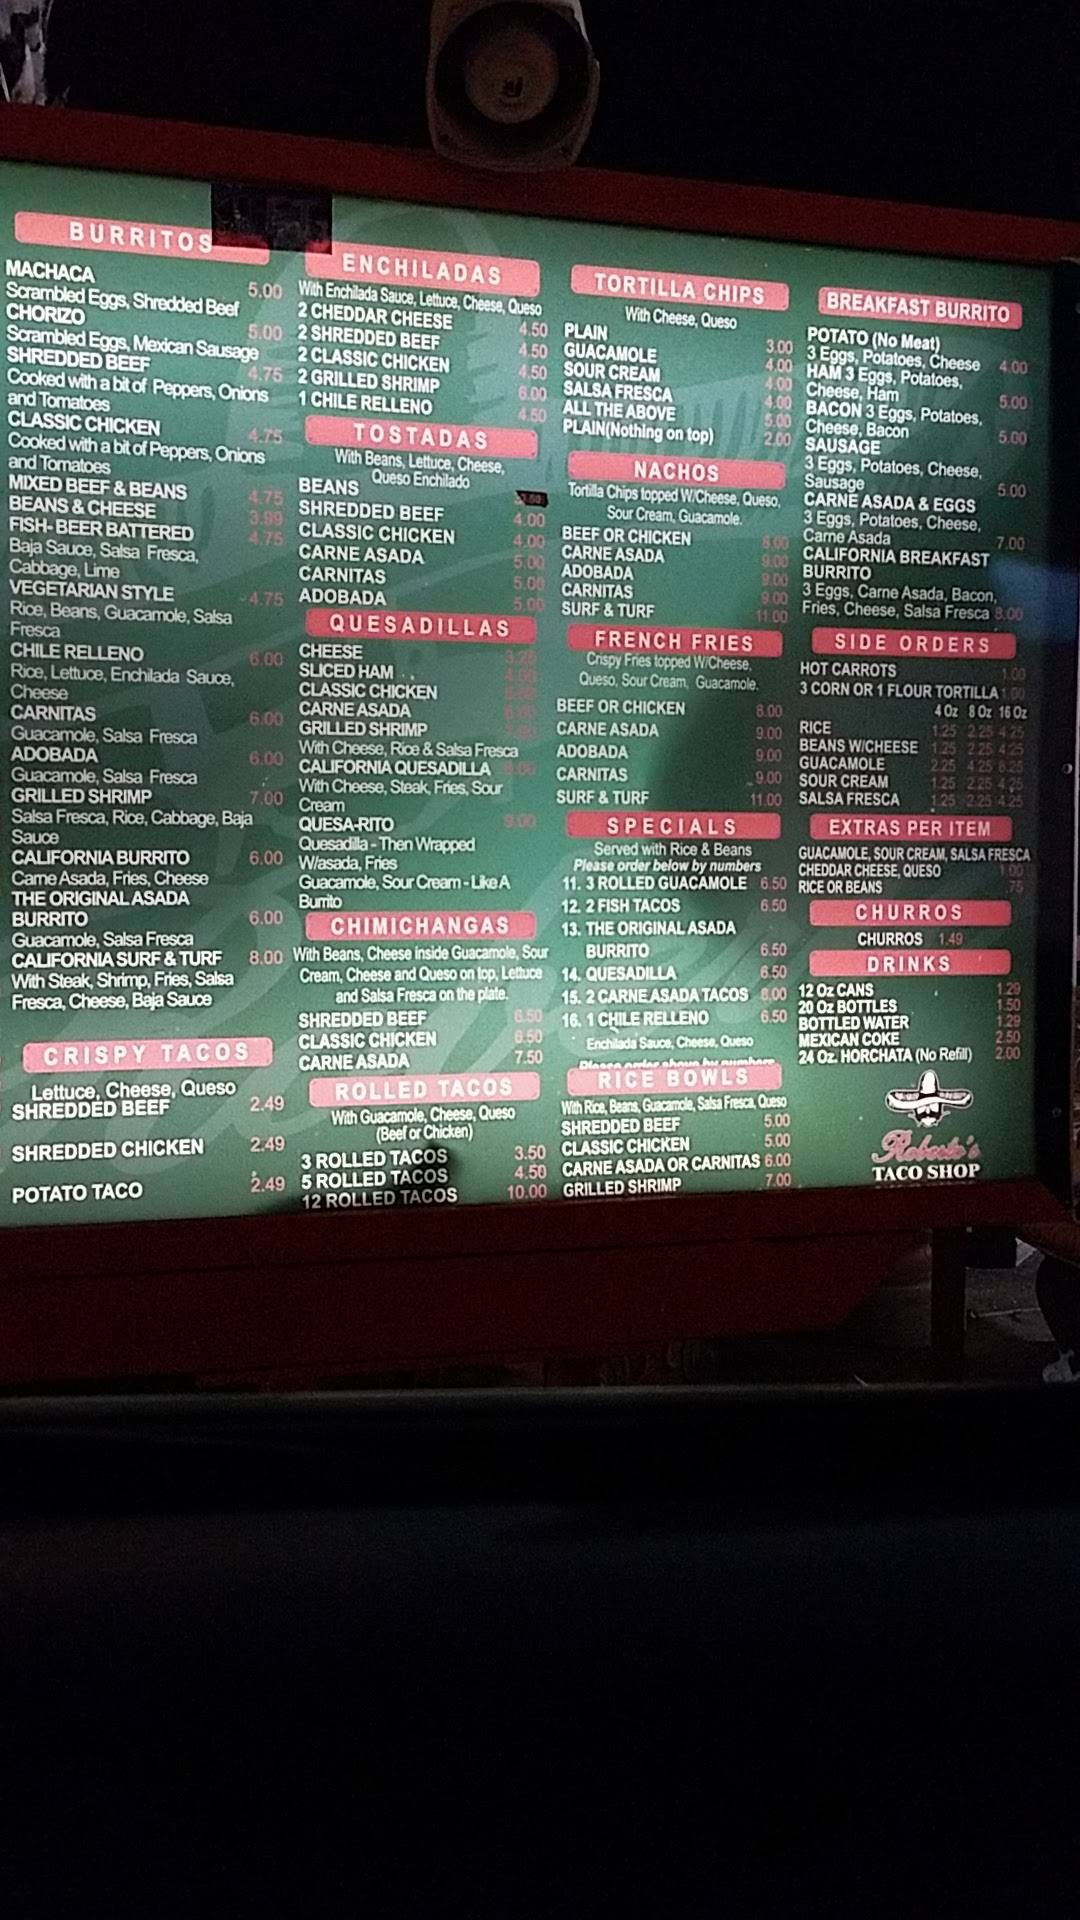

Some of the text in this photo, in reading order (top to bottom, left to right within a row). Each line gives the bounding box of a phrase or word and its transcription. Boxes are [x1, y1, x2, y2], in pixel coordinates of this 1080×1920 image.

[69, 221, 213, 253] BURRITOS
[5, 259, 282, 299] MACHACA 5.00
[343, 254, 501, 285] ENCHILADAS
[6, 282, 240, 317] Scrambled Eggs, Shredded Beef
[299, 280, 542, 317] With Enchilada Sauce, Lettuce, Cheese, Queso
[595, 273, 764, 304] TORTILLA CHIPS
[626, 306, 737, 330] With Cheese, Queso
[827, 292, 1010, 323] BREAKFAST BURRITO
[6, 303, 282, 341] CHORIZO 5.00
[298, 302, 548, 337] 2 CHEDDAR CHEESE 4.50
[808, 327, 940, 352] POTATO (No Meat)
[7, 346, 150, 372] SHREDDED BEEF
[564, 342, 792, 372] GUACAMOLE 4.00
[807, 364, 962, 389] HAM 3 Eggs, Potatoes,
[806, 383, 1027, 409] Cheese, Ham 5.00
[563, 400, 676, 422] ALL THE ABOVE
[354, 423, 488, 450] TOSTADAS
[667, 428, 682, 440] on
[687, 428, 714, 446] top)
[372, 469, 469, 489] Queso Enchilado
[634, 460, 719, 482] NACHOS
[9, 475, 283, 506] MIXED BEEF & BEANS 4.75
[56, 519, 101, 536] BEER
[106, 523, 194, 542] BATTERED
[299, 522, 545, 549] CLASSIC CHICKEN 4.00
[10, 580, 174, 602] VEGETARIAN STYLE
[330, 614, 509, 637] QUESADILLAS
[595, 630, 753, 652] FRENCH FRIES
[835, 633, 989, 652] SIDE ORDERS
[299, 663, 393, 679] SLICED HAM
[800, 661, 896, 678] HOT CARROTS
[557, 699, 594, 713] BEEF
[598, 700, 619, 714] OR
[623, 700, 685, 716] CHICKEN
[800, 739, 845, 753] BEANS
[299, 759, 392, 775] CALIFORNIA
[395, 760, 491, 777] QUESADILLA
[12, 788, 283, 806] GRILLED SHRIMP 7.00
[607, 818, 736, 835] SPECIALS
[829, 819, 990, 836] EXTRAS PER ITEM
[594, 841, 752, 857] Served with Rice & Beans
[574, 859, 761, 875] Please order below by numbers
[562, 899, 787, 914] 12. 2 FISH TACOS 6.50
[856, 904, 962, 921] CHURROS
[331, 916, 509, 936] CHIMICHANGAS
[858, 932, 963, 946] CHURROS 1.49
[12, 950, 283, 968] CALIFORNIA SURF & TURF 8.00
[868, 956, 950, 973] DRINKS
[12, 970, 234, 990] With Steak, Shrimp, Fries, Salsa
[799, 984, 814, 997] 12
[817, 983, 834, 996] Oz
[837, 983, 874, 997] CANS
[799, 1031, 1021, 1047] MEXICAN COKE 2.50
[44, 1042, 249, 1066] CRISPY TACOS
[299, 1050, 542, 1071] CARNE ASADA 7.50
[799, 1047, 972, 1064] 24 Oz. HORCHATA (No Refill)
[336, 1078, 512, 1101] ROLLED TACOS
[599, 1068, 748, 1089] RICE BOWLS
[32, 1079, 236, 1102] Lettuce, Cheese, Queso
[377, 1123, 473, 1144] (Beef or Chicken)
[12, 1136, 285, 1162] SHREDDED CHICKEN 2.49
[301, 1145, 546, 1169] 3 ROLLED TACOS 3.50
[562, 1153, 791, 1177] CARNE ASADA OR CARNITAS 6.00
[872, 1164, 980, 1182] TACO SHOP
[12, 1177, 285, 1204] POTATO TACO 2.49
[563, 1173, 791, 1197] GRILLED SHRIMP 7.00
